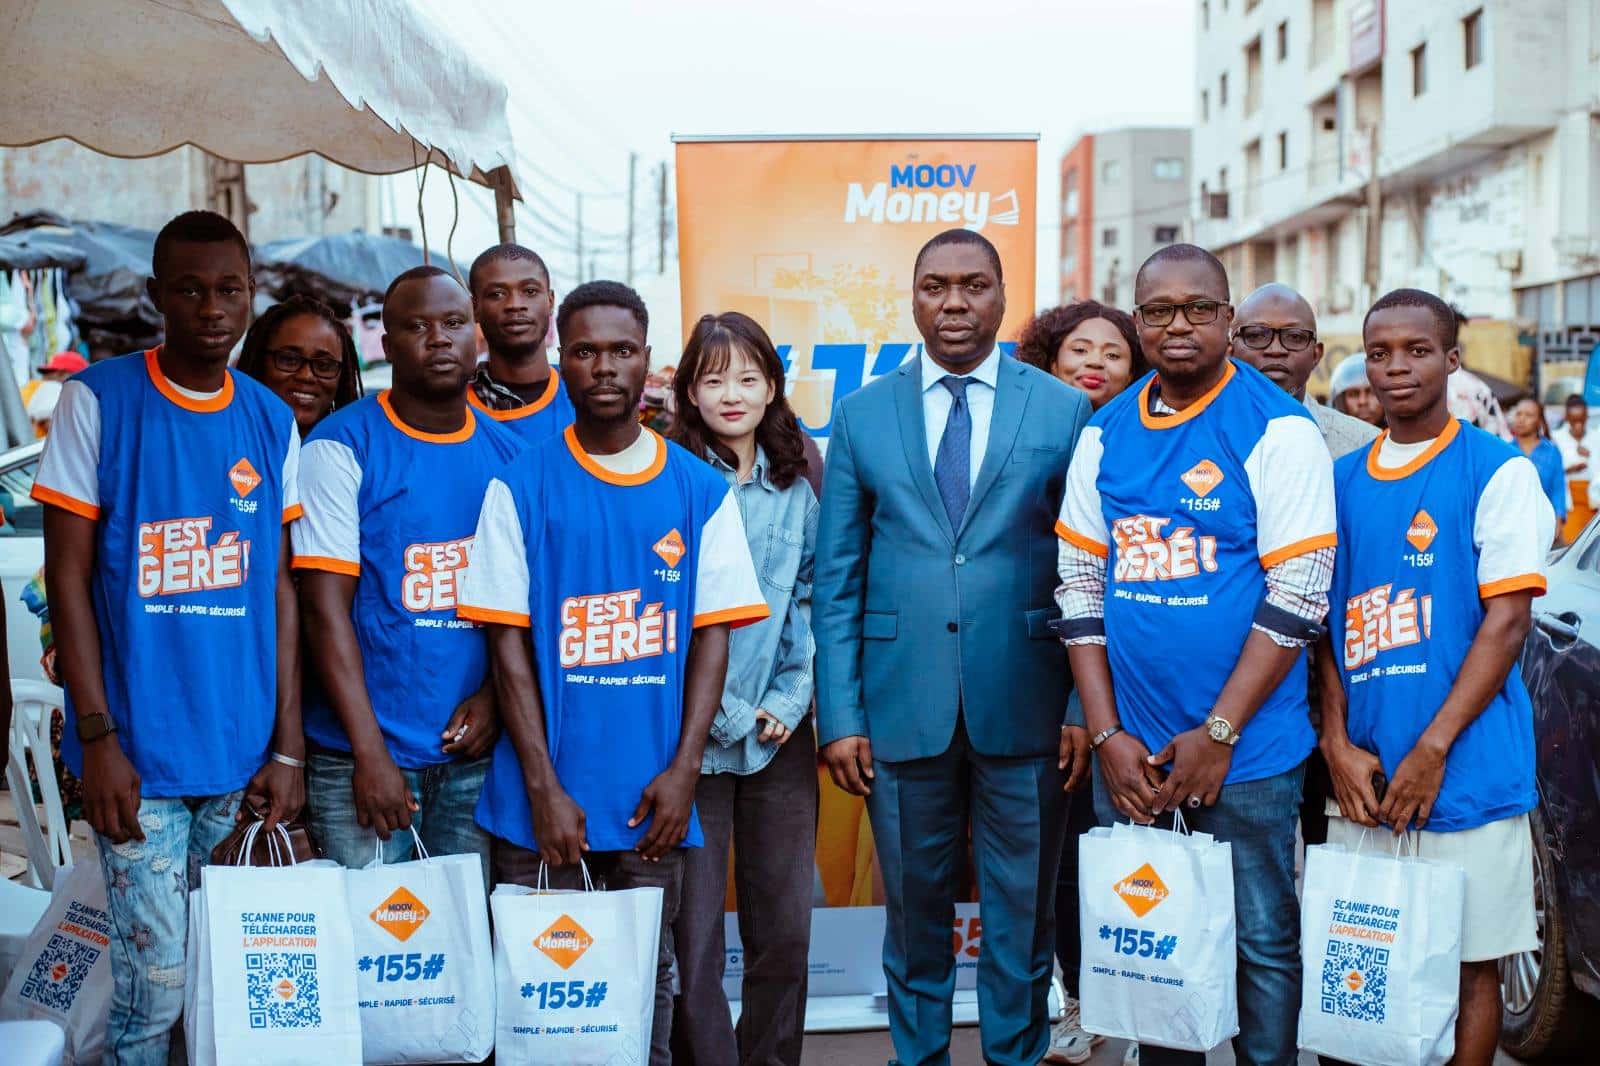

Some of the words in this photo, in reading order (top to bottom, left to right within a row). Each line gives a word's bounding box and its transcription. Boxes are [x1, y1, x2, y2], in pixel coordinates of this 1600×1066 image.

[890, 163, 977, 189] MOOV
[844, 182, 991, 232] Money
[138, 517, 212, 553] C'EST
[561, 589, 641, 627] C'EST
[566, 674, 595, 685] SIMPLE
[1119, 882, 1157, 900] Money
[375, 907, 417, 924] Money
[388, 903, 413, 912] MOOV
[1334, 899, 1371, 914] SCANNE
[1370, 905, 1400, 919] POUR
[240, 912, 285, 923] SCANNE
[286, 912, 316, 923] POUR
[1332, 911, 1398, 932] TÉLÉCHARGER
[243, 923, 317, 935] TÉLÉCHARGER
[1329, 923, 1396, 944] L'APPLICATION
[243, 936, 317, 948] L'APPLICATION
[539, 935, 579, 951] Money
[1092, 966, 1116, 977] SIMPLE
[1121, 970, 1146, 981] RAPIDE
[1150, 975, 1184, 987] SÉCURISÉ
[358, 999, 379, 1008] MPLE
[384, 998, 413, 1008] RAPIDE
[418, 994, 456, 1005] SÉCURISÉ
[512, 1026, 540, 1035] SIMPLE
[546, 1026, 575, 1034] RAPIDE
[580, 1024, 618, 1033] SÉCURISÉ
